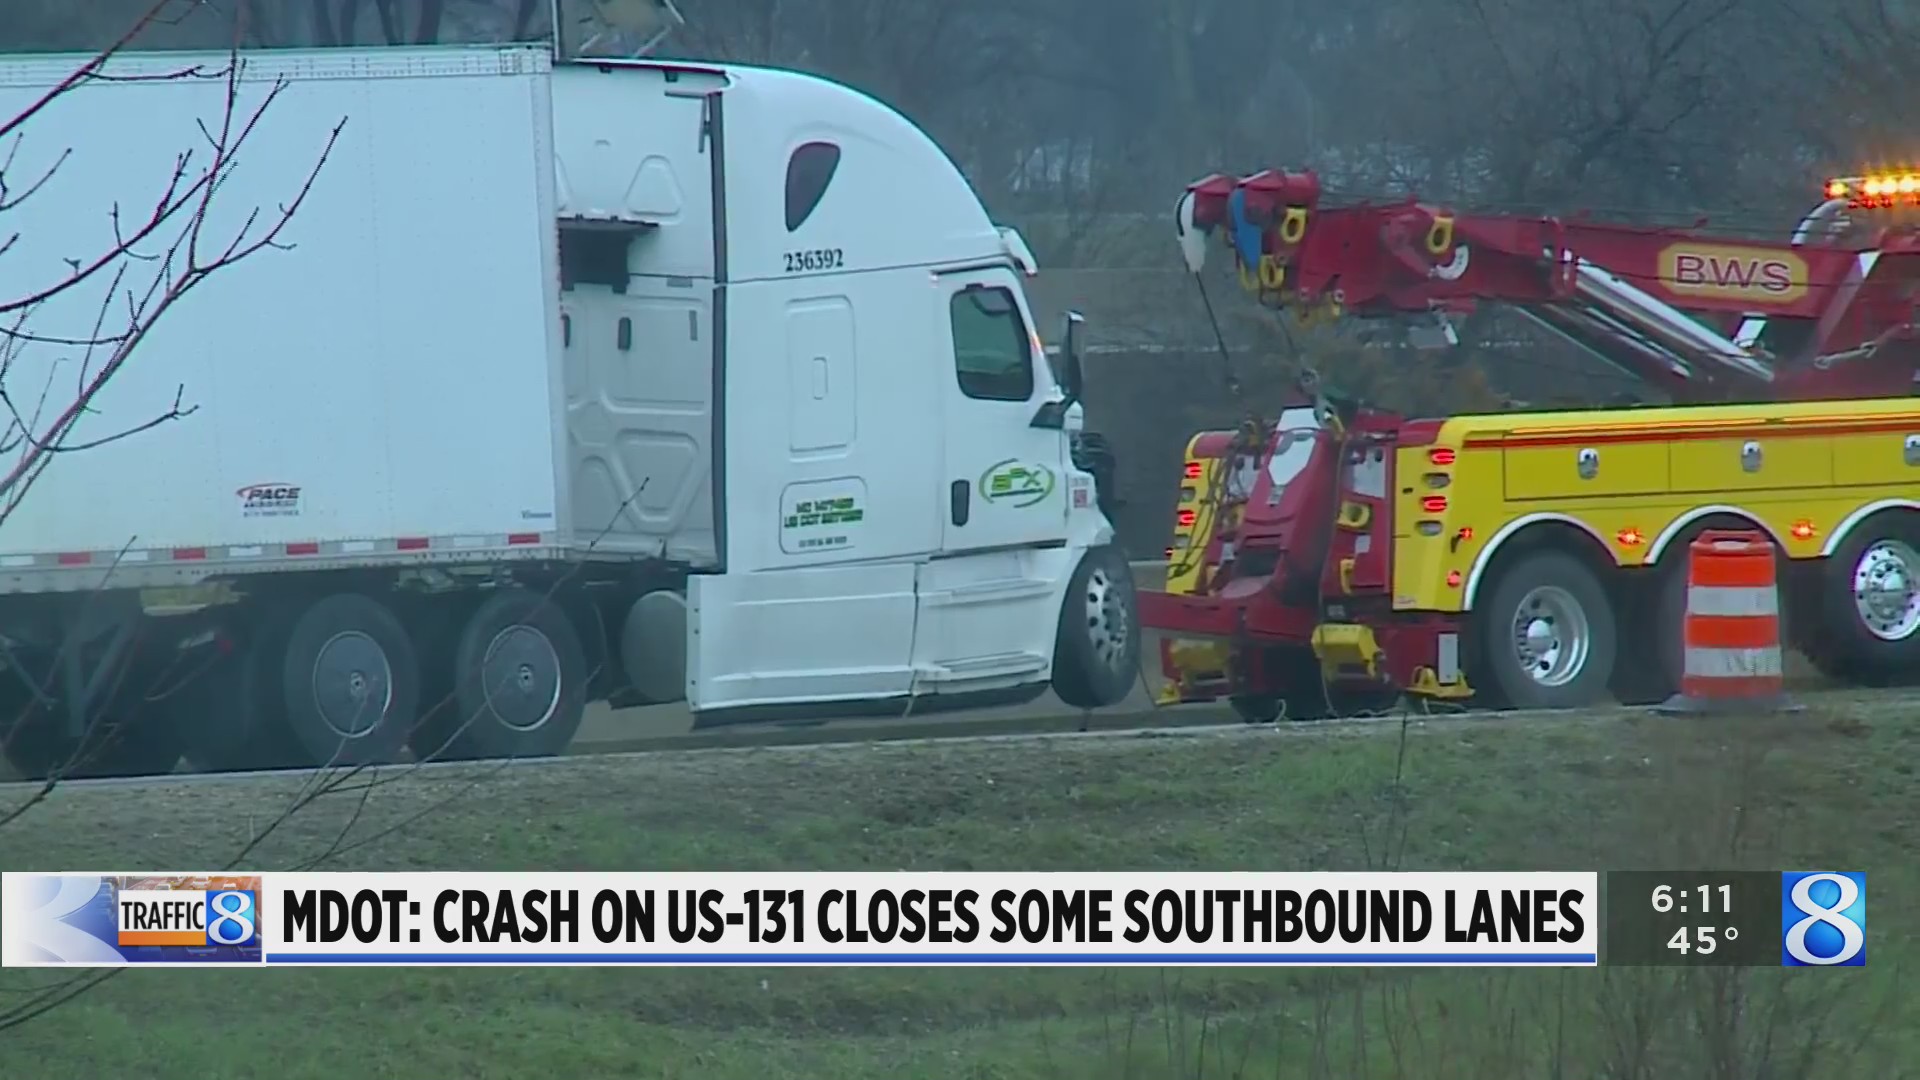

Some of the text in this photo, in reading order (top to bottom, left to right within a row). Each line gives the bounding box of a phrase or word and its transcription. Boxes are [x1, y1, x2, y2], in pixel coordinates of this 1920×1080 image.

[783, 248, 843, 272] 236392
[1675, 254, 1792, 292] BWS
[247, 487, 302, 501] PACE
